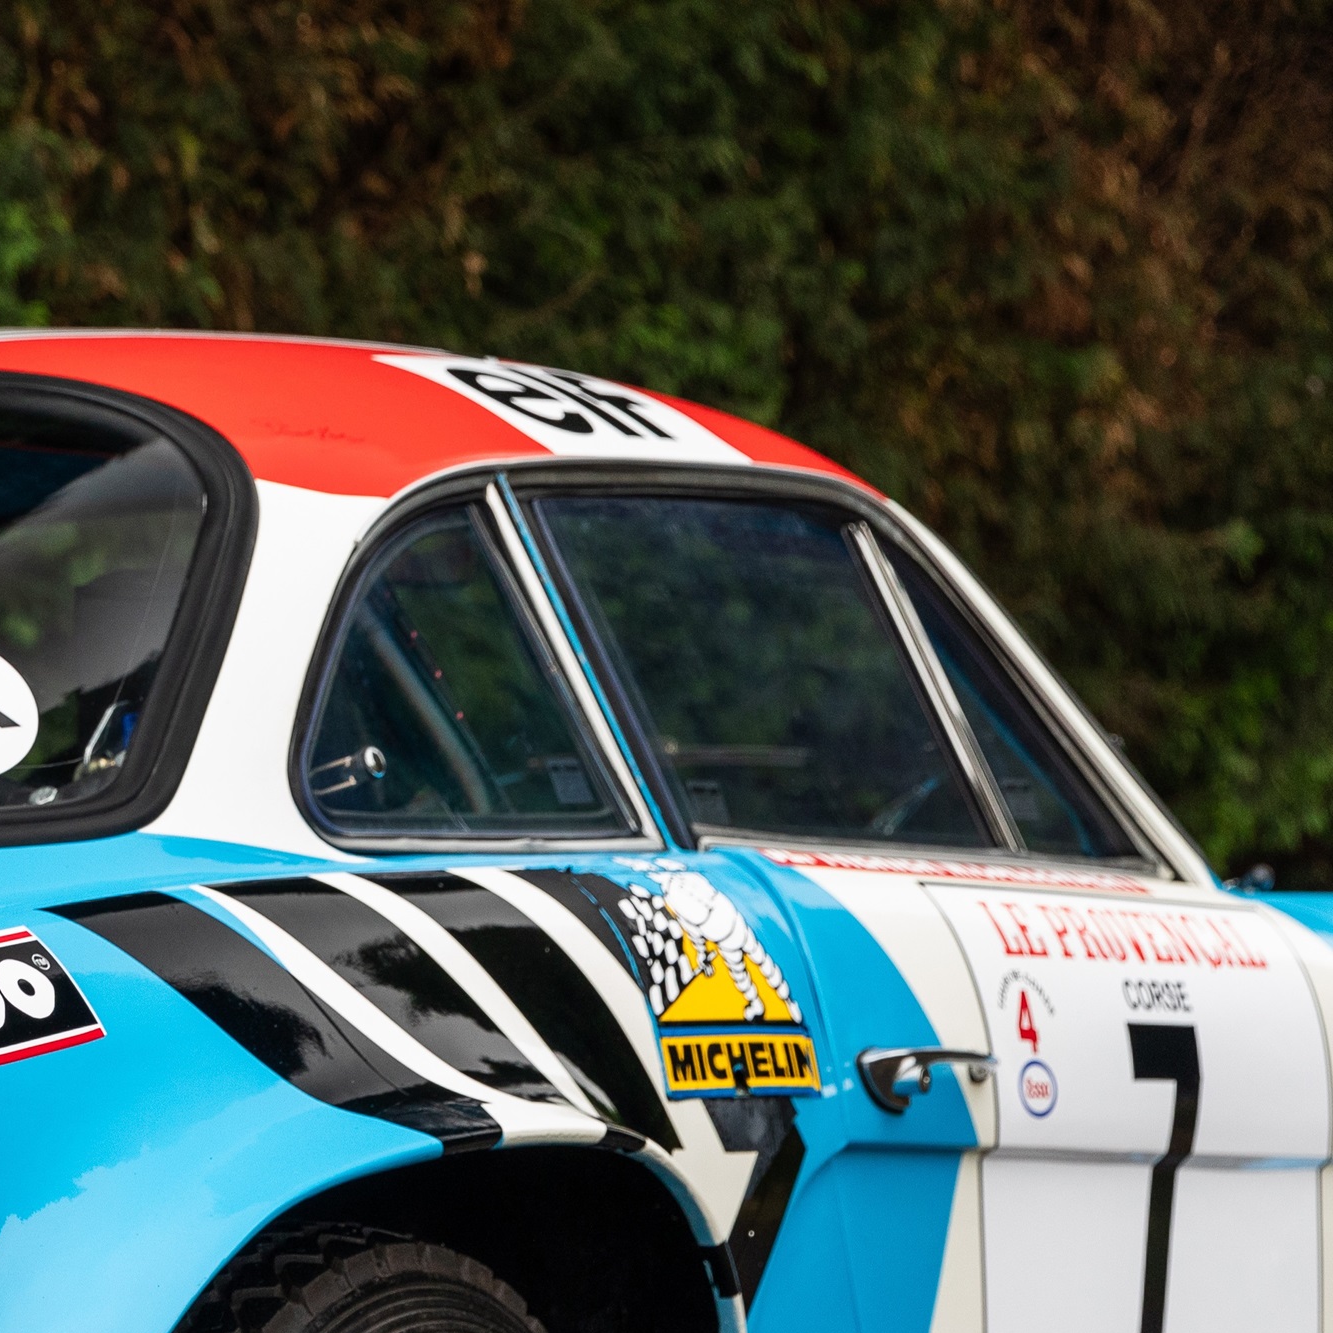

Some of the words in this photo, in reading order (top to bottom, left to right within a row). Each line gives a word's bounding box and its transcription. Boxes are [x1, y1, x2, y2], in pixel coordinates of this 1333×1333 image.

[446, 368, 674, 440] elf
[978, 901, 1049, 958] LE
[1036, 904, 1268, 970] PROVENÇAL
[1018, 990, 1039, 1054] 4
[1122, 979, 1193, 1013] CORSE
[668, 1042, 811, 1082] MICHELIN
